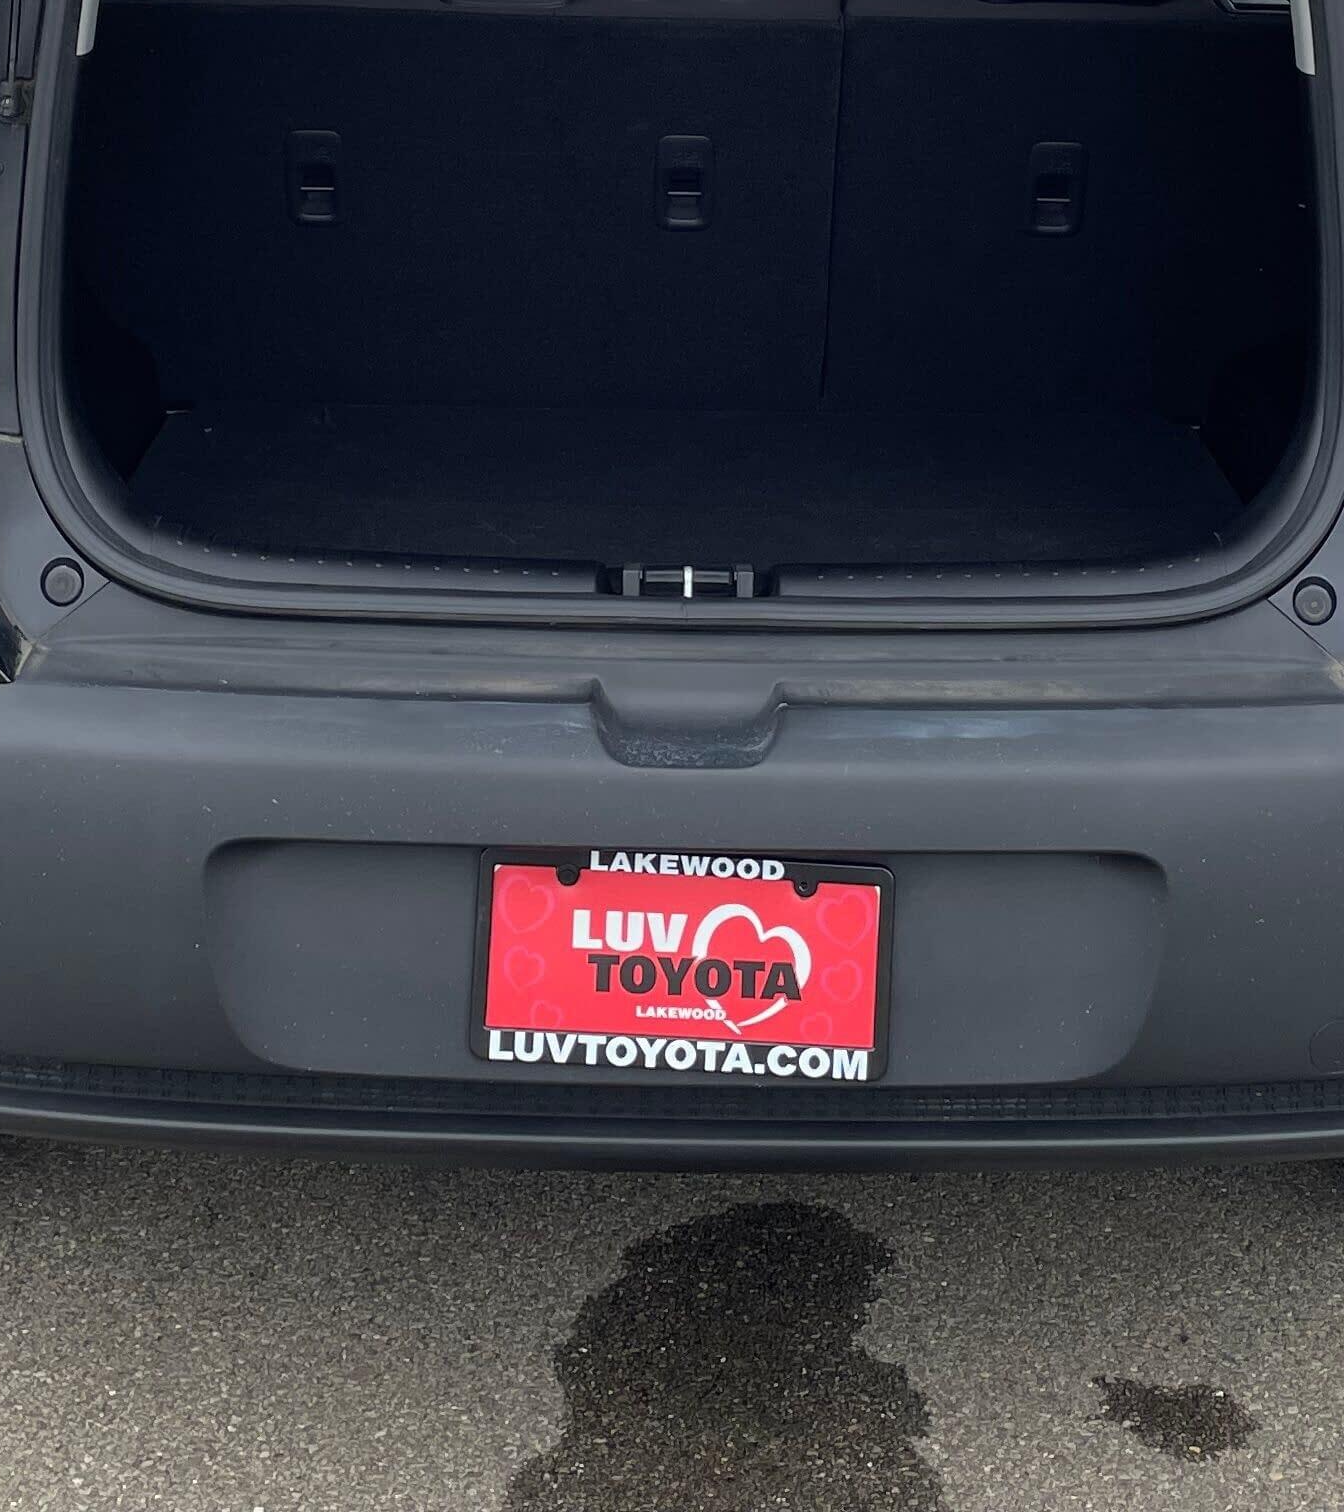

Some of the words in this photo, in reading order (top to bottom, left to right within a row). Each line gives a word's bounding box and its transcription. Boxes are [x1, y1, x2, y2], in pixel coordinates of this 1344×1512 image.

[590, 850, 785, 881] LAKEWOOD
[572, 909, 688, 953] LUV
[588, 954, 802, 1001] TOYOTA
[635, 1005, 726, 1021] LAKEWOOD
[488, 1030, 868, 1081] LUVTOYOTA.COM
